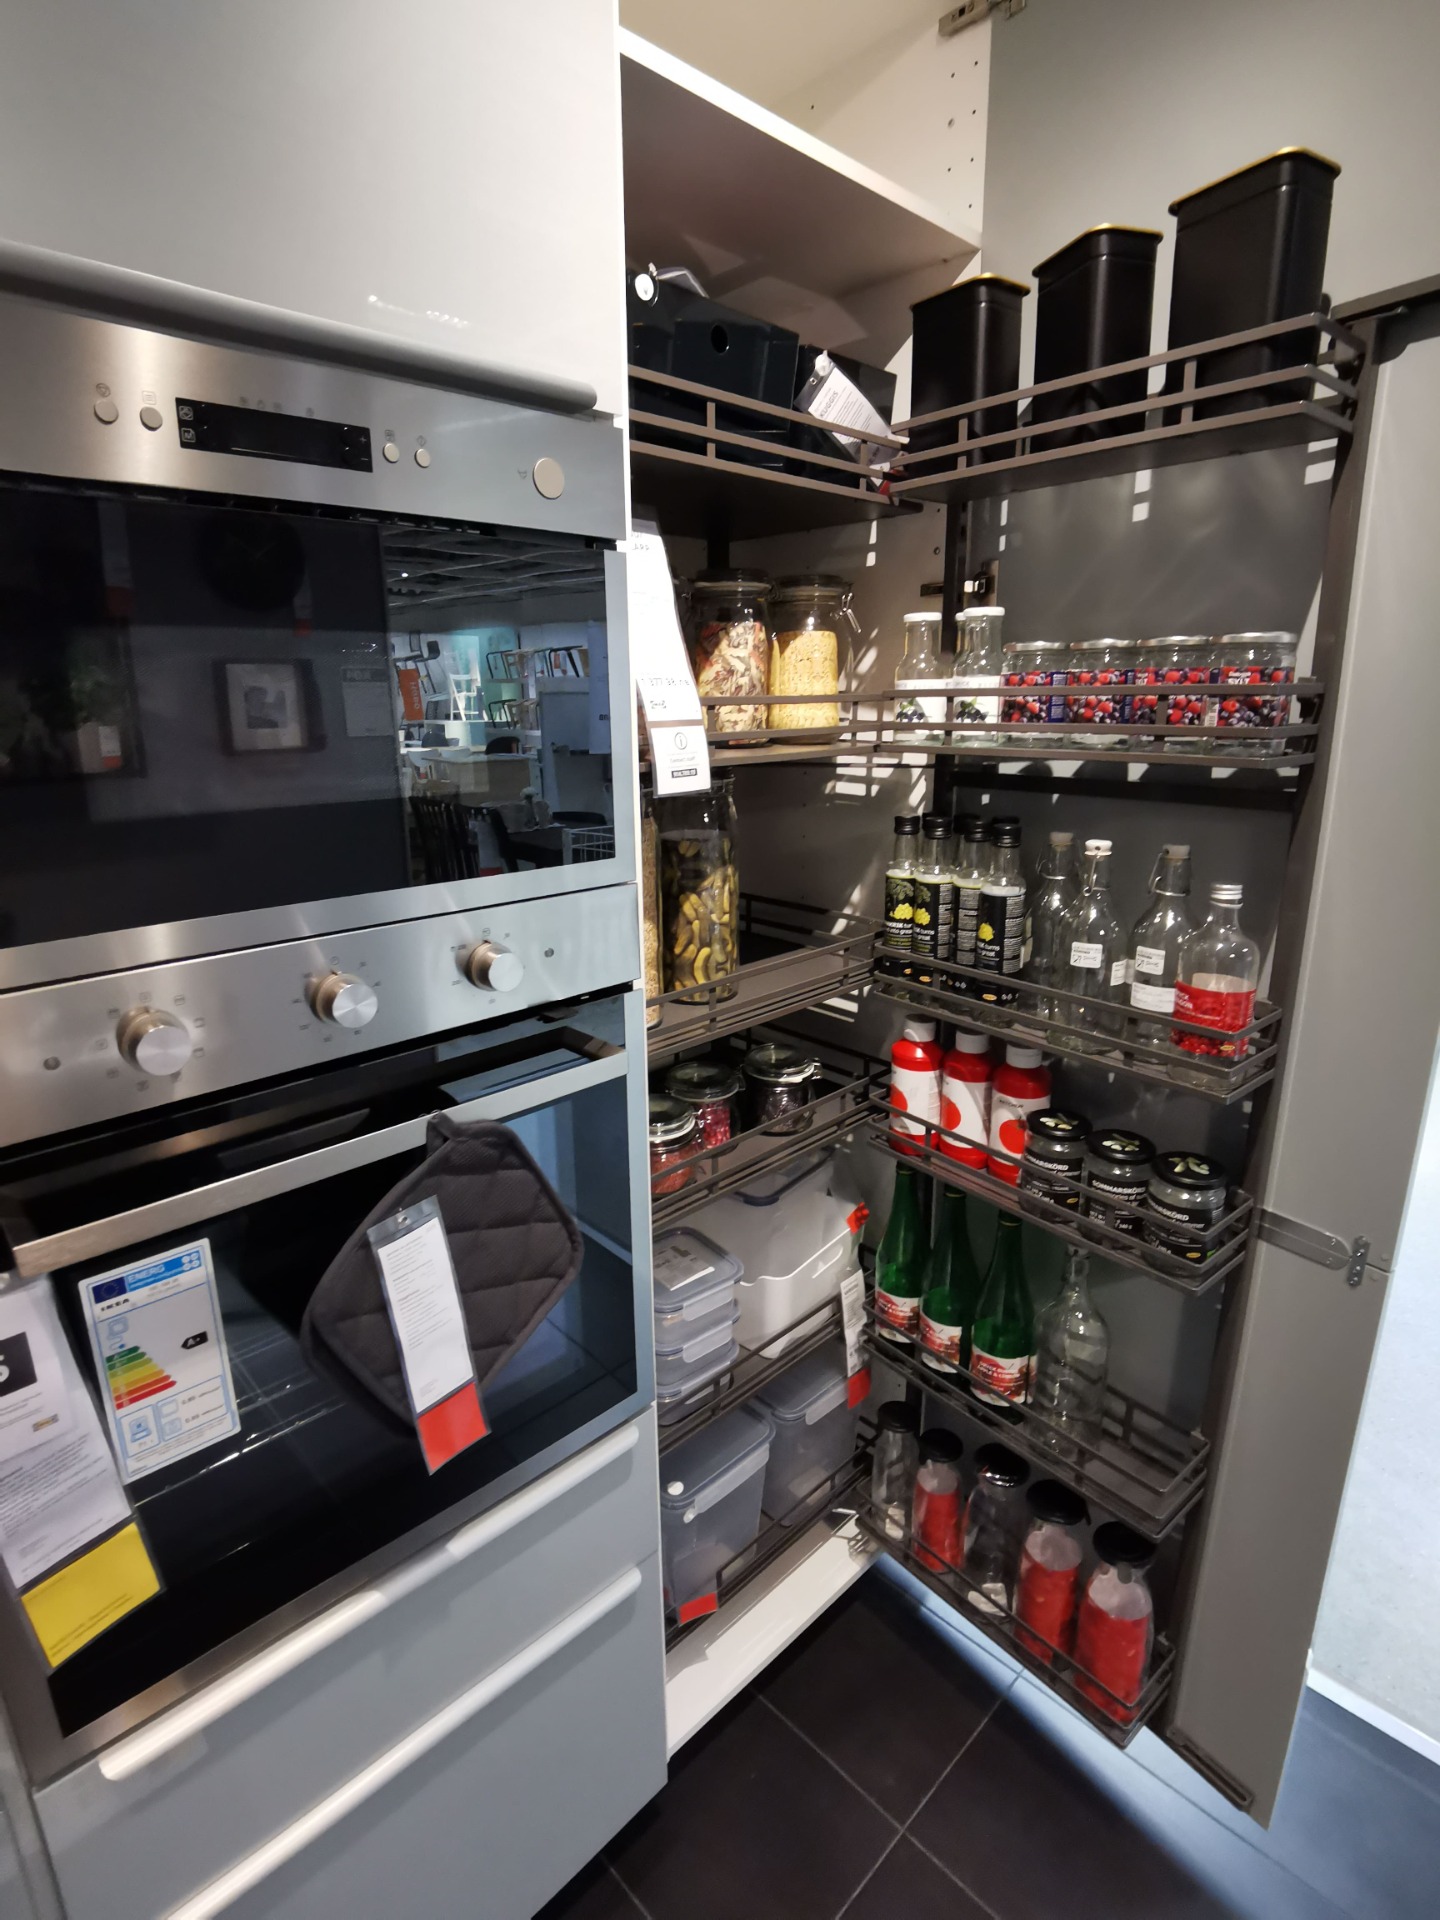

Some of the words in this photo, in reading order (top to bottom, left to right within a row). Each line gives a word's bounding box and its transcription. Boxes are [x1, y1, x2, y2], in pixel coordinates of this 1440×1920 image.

[819, 390, 839, 418] KUGGIS
[128, 1264, 165, 1282] ENERG
[100, 1298, 130, 1312] IKEA
